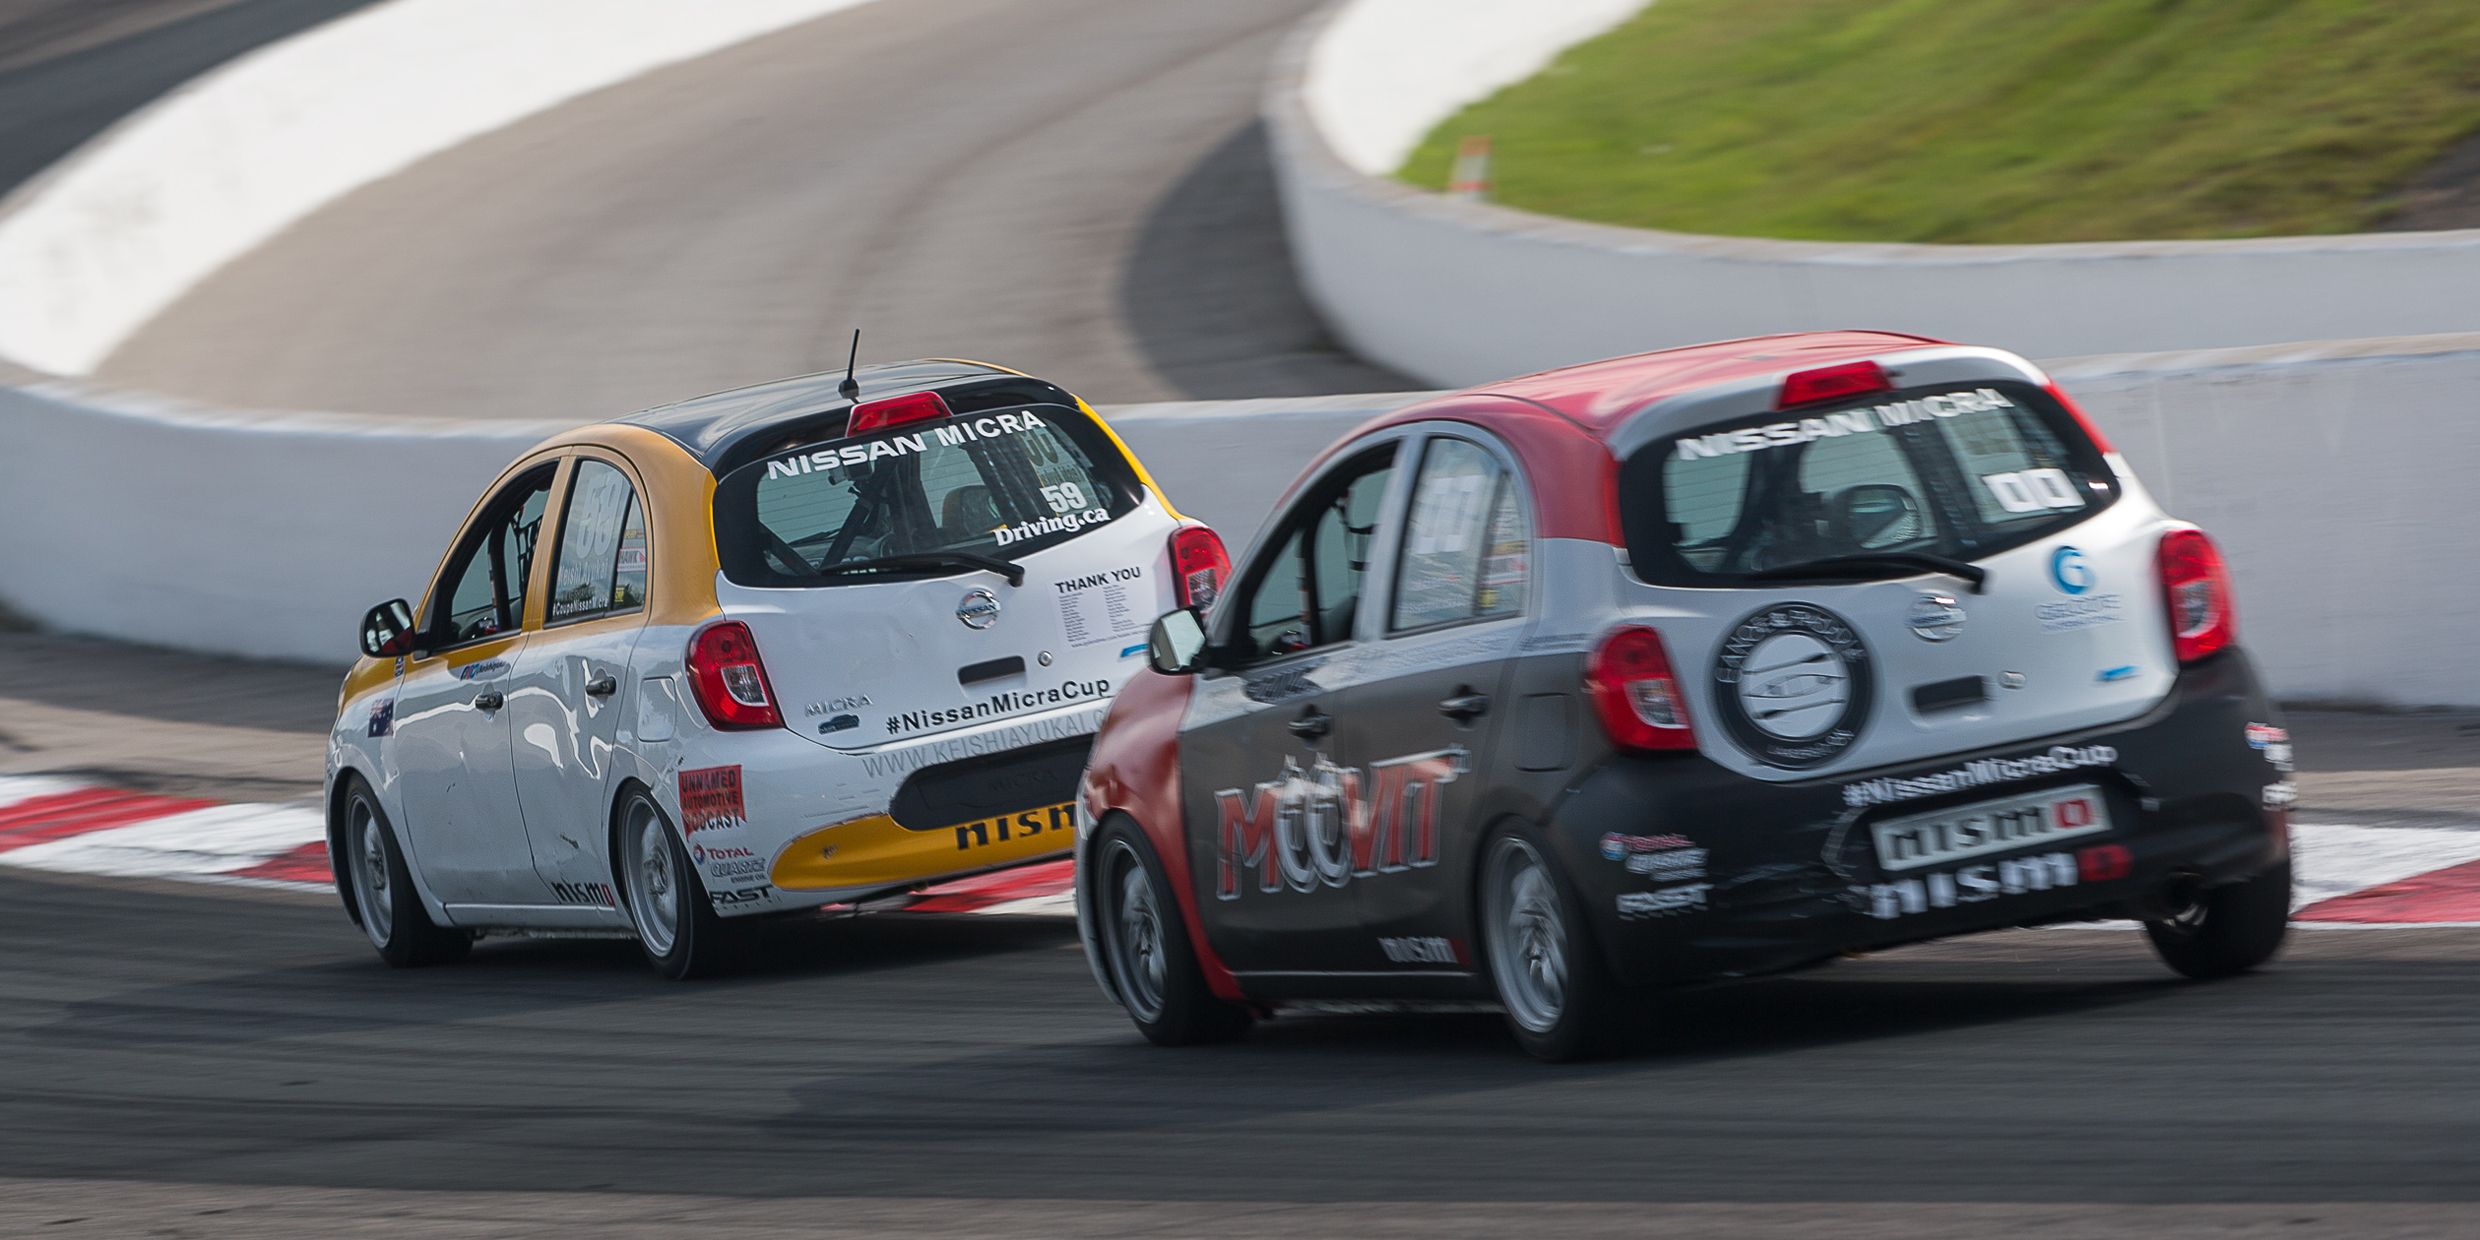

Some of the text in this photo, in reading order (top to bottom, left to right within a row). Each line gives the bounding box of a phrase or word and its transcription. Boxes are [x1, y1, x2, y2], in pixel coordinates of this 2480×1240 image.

[1676, 388, 2014, 460] NISSAN MICRA
[767, 433, 927, 480] NISSAN
[934, 410, 1047, 448] MICRA
[1039, 481, 1088, 513] 59
[1982, 467, 2087, 513] 00
[993, 507, 1112, 546] Driving.ca
[1055, 566, 1141, 593] THANK YOU
[804, 693, 874, 718] MICRA
[886, 678, 1110, 735] #NissanMicraCup
[682, 769, 737, 792] UNNAMED
[1842, 745, 2118, 807] #NissanMicraCup
[682, 790, 738, 810] AUTOMOTIVE
[1886, 798, 2096, 861] nismo
[706, 846, 754, 860] TOTAL
[551, 881, 616, 907] nismo
[1868, 844, 2134, 919] nismo
